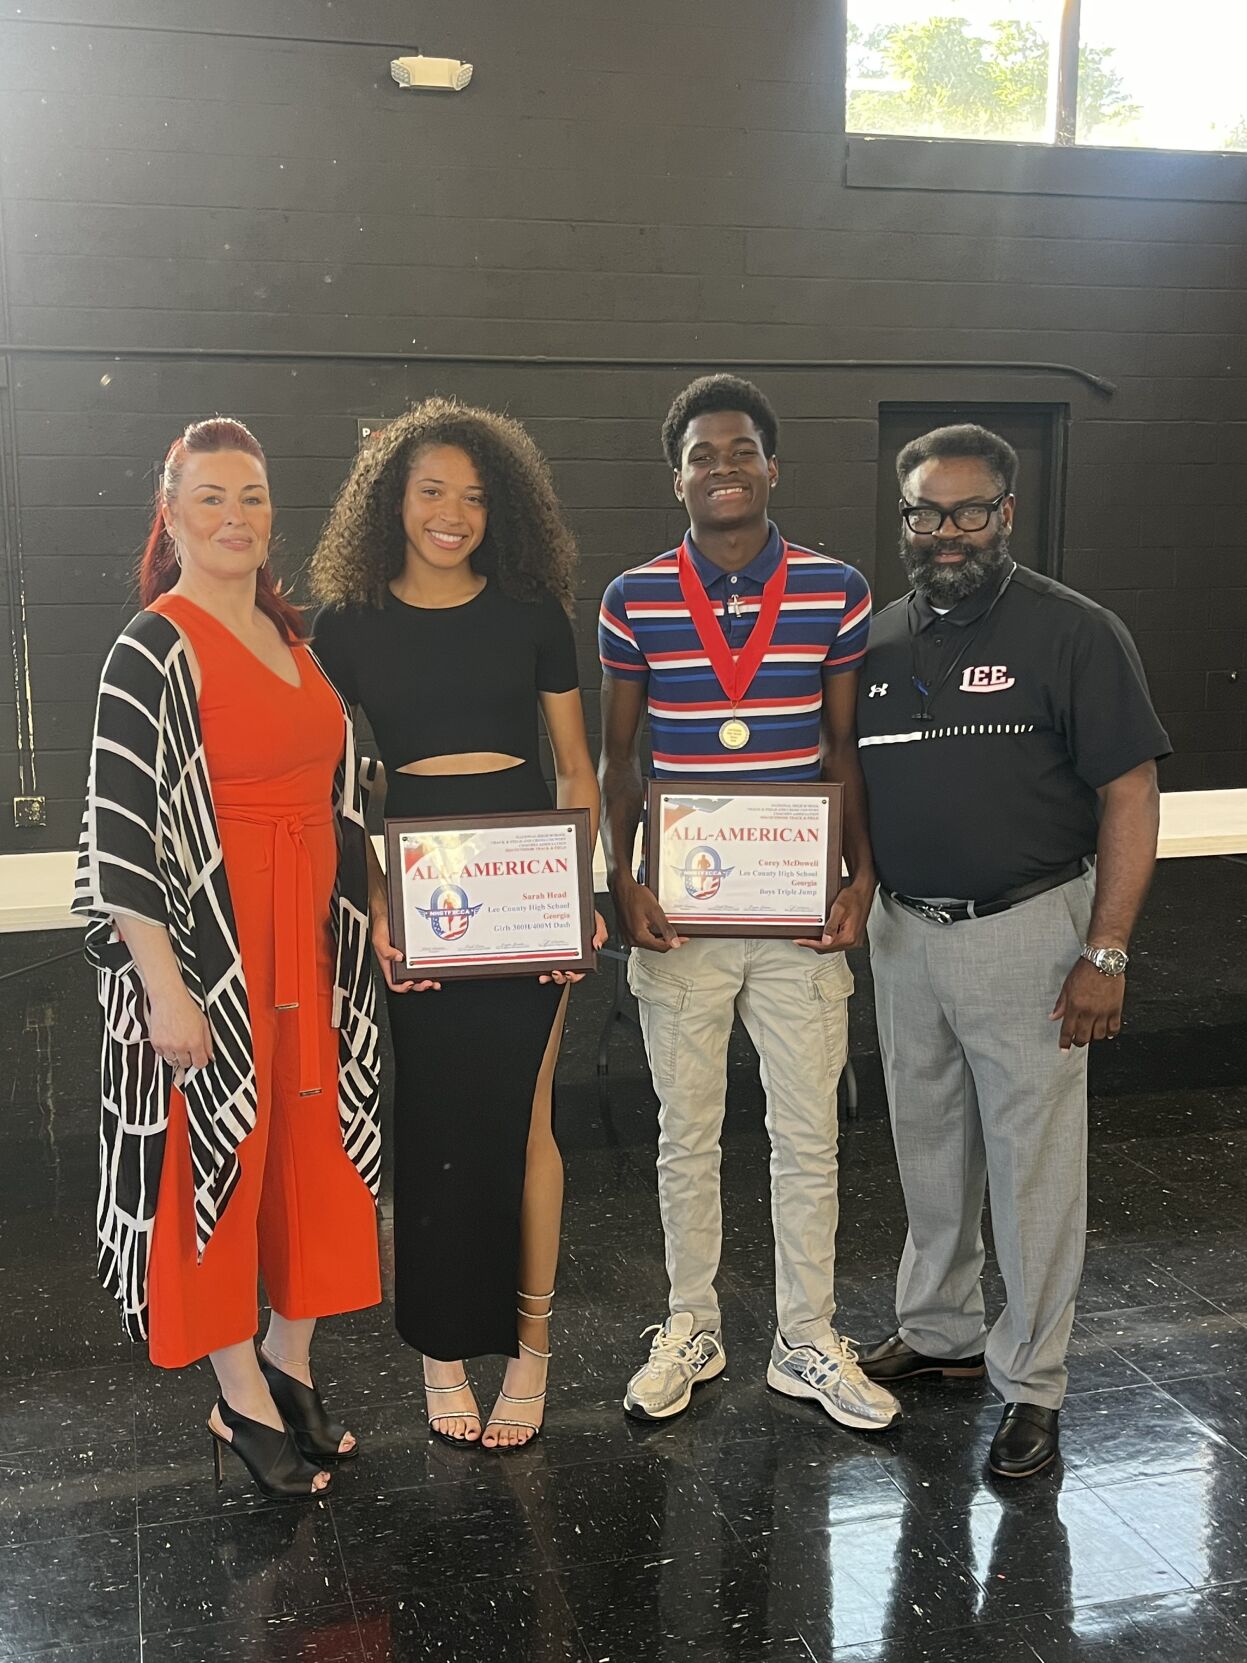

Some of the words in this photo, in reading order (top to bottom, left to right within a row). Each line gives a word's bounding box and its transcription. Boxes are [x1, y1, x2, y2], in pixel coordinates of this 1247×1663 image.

[959, 665, 1016, 693] LEE
[670, 827, 819, 843] ALL-AMERICAN
[758, 859, 780, 868] Corey
[783, 859, 819, 867] McDowell
[778, 870, 794, 878] High
[791, 879, 818, 887] Georgia
[522, 892, 545, 900] Sarah
[547, 891, 567, 899] Head
[777, 888, 797, 896] Triple
[502, 905, 527, 913] County
[547, 902, 570, 910] School
[543, 912, 570, 920] Georgia
[553, 921, 571, 929] Dash
